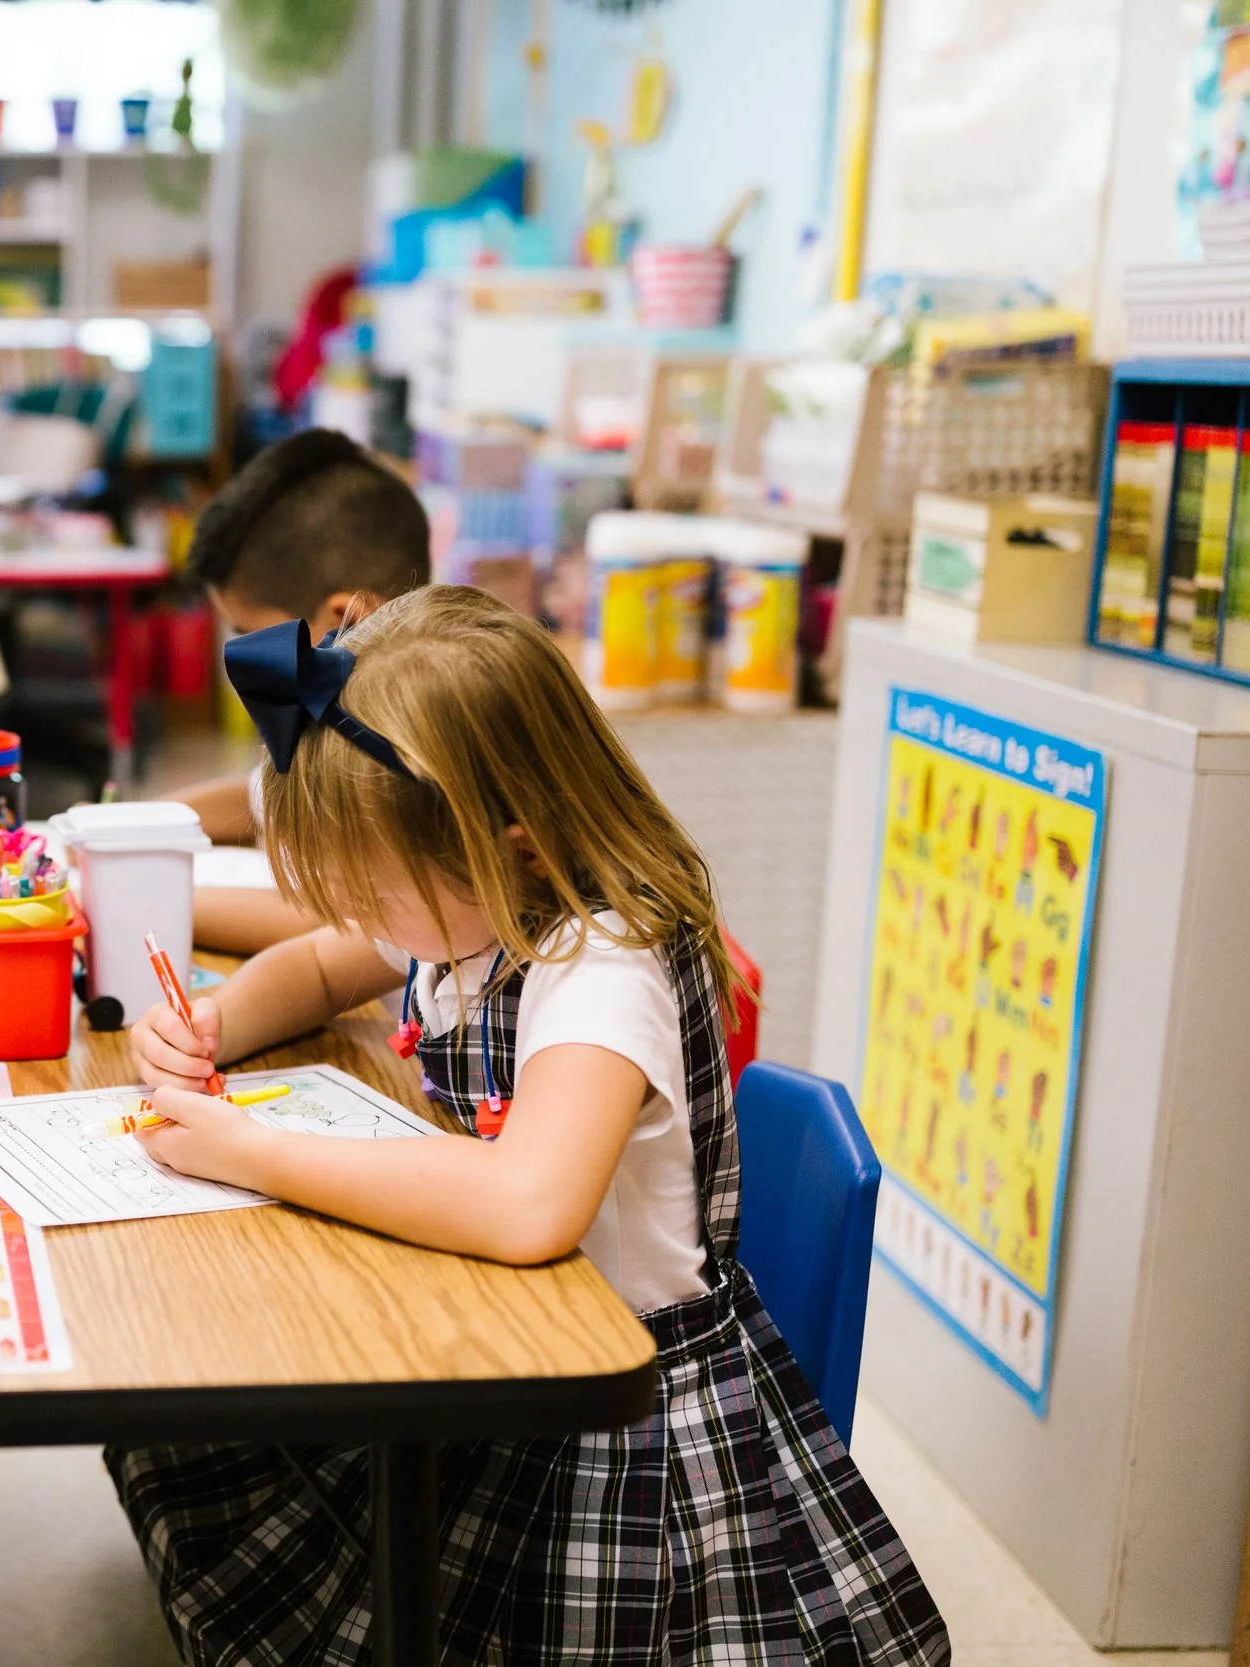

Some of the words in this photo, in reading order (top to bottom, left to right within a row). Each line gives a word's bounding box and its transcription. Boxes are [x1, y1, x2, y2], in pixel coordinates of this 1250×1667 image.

[896, 692, 941, 741] Let's
[942, 712, 1002, 765] Learn
[1004, 736, 1030, 774] to
[1032, 744, 1094, 798] Sign!
